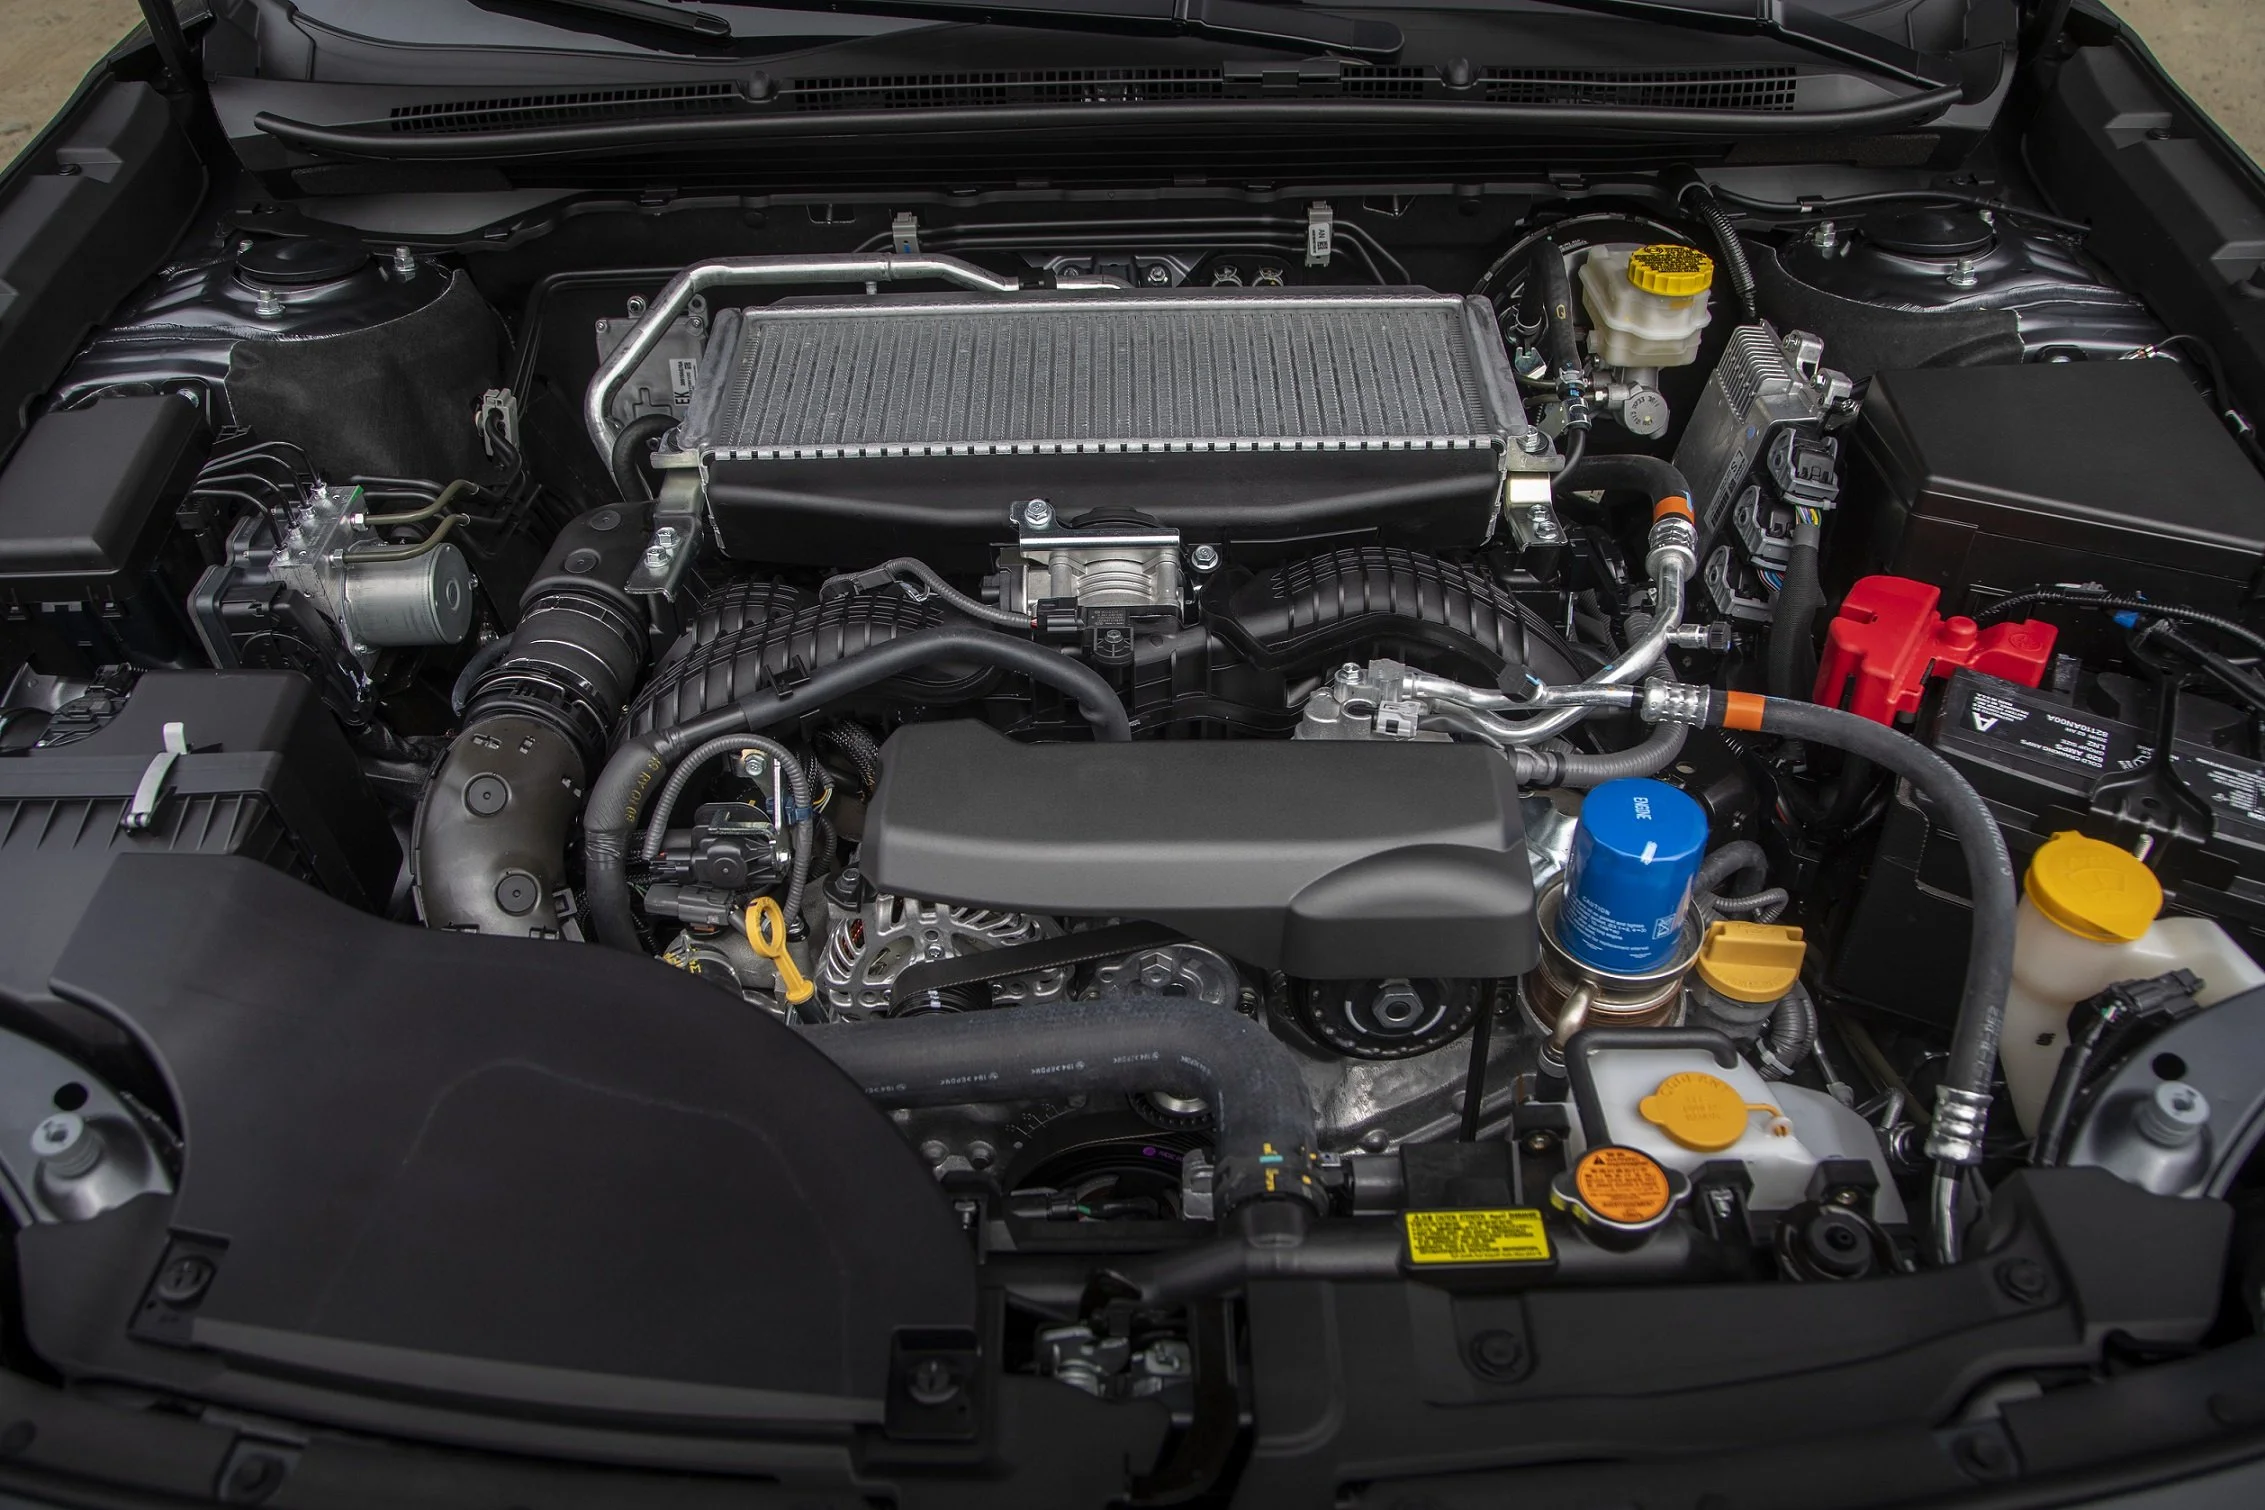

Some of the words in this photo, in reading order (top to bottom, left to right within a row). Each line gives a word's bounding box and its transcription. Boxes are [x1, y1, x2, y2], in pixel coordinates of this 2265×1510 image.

[674, 391, 690, 404] EK
[2045, 714, 2109, 738] 82110AN00A
[2020, 738, 2042, 749] AMPS
[2060, 738, 2078, 747] SIZE
[2041, 745, 2081, 761] CRANKING
[2054, 743, 2084, 756] AMPS
[2078, 744, 2105, 756] GROUP
[2081, 758, 2103, 768] COLD
[2086, 753, 2104, 763] 620
[1633, 797, 1652, 821] ENGINE
[1581, 896, 1611, 916] CAUTION
